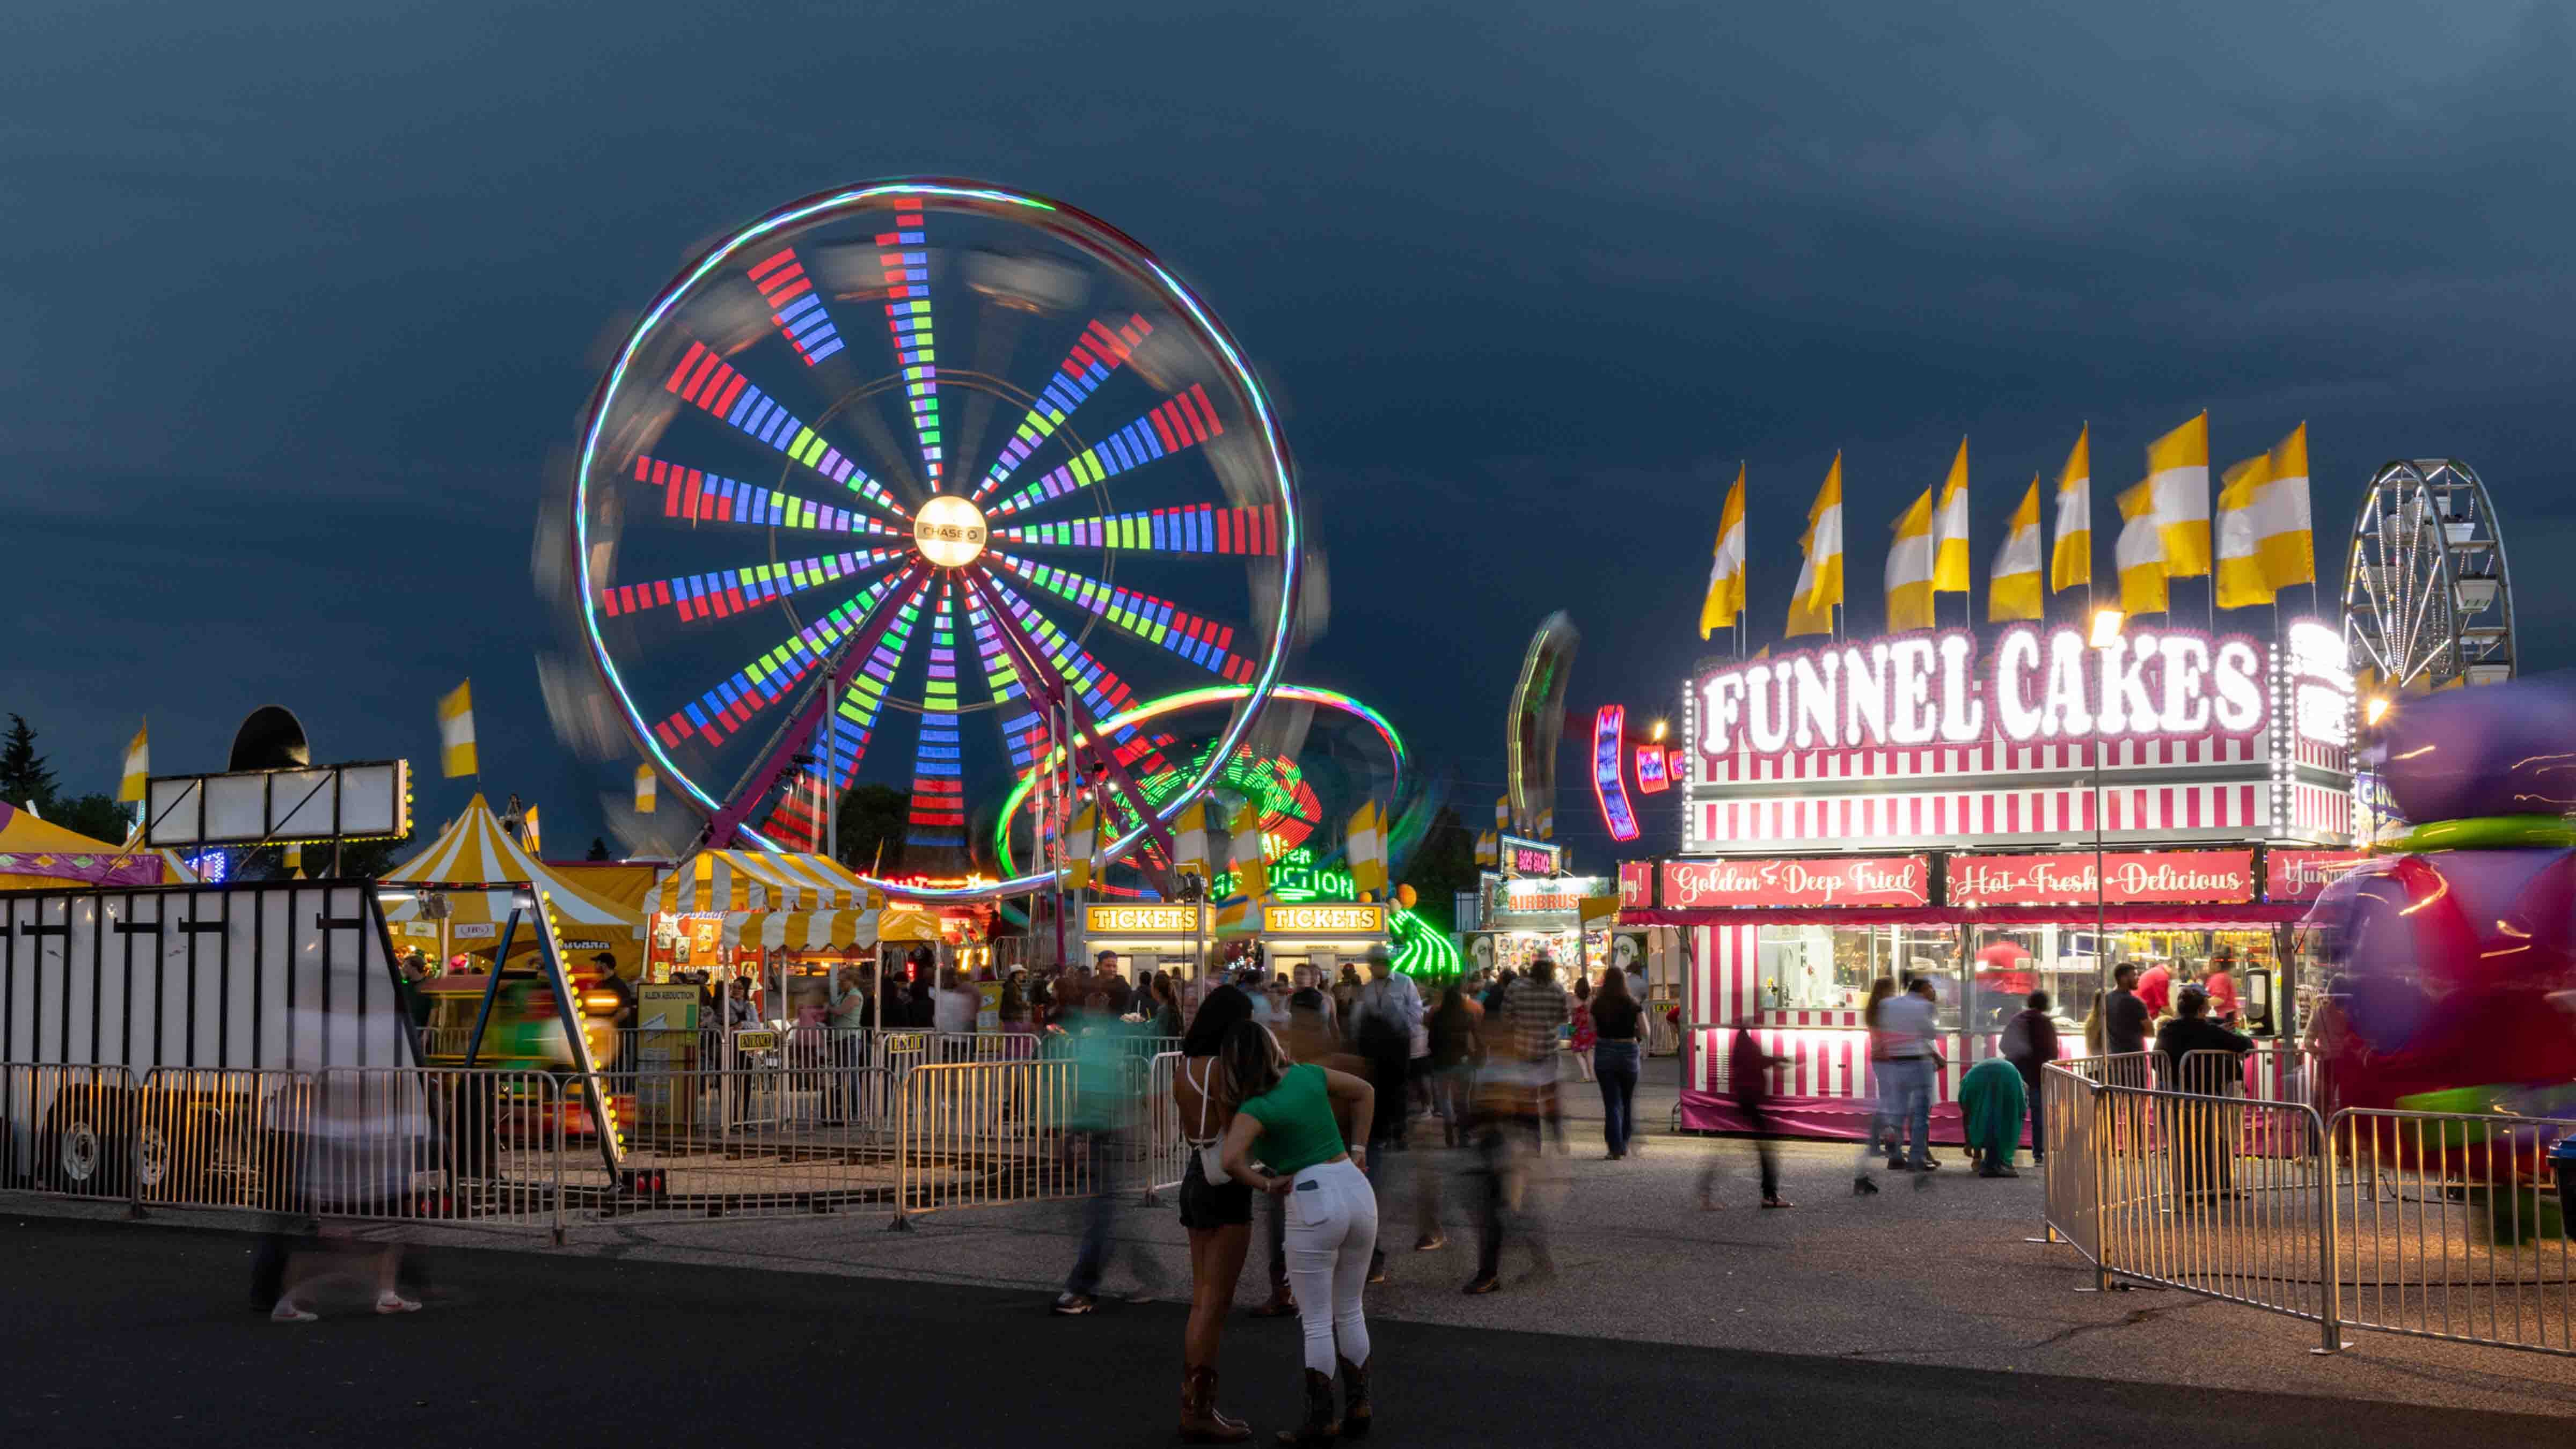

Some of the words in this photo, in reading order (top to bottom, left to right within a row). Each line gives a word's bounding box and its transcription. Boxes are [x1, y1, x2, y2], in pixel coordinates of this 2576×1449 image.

[923, 527, 963, 538] CHASE
[1703, 634, 1984, 753] FUNNEL
[1997, 629, 2261, 741] CAKES
[2361, 781, 2398, 809] CAN
[1671, 866, 1761, 903] Golden
[1781, 864, 1846, 902] Deep
[1848, 861, 1917, 893] Fried
[1956, 865, 2014, 895] Hot
[2029, 862, 2099, 893] Fresh
[2118, 862, 2244, 895] Delicious
[1509, 893, 1589, 911] AIRBRUS
[1094, 909, 1197, 929] TICKETS
[1271, 909, 1375, 928] TICKETS
[742, 1034, 772, 1048] ENTRANCE
[893, 1035, 923, 1050] EXIT
